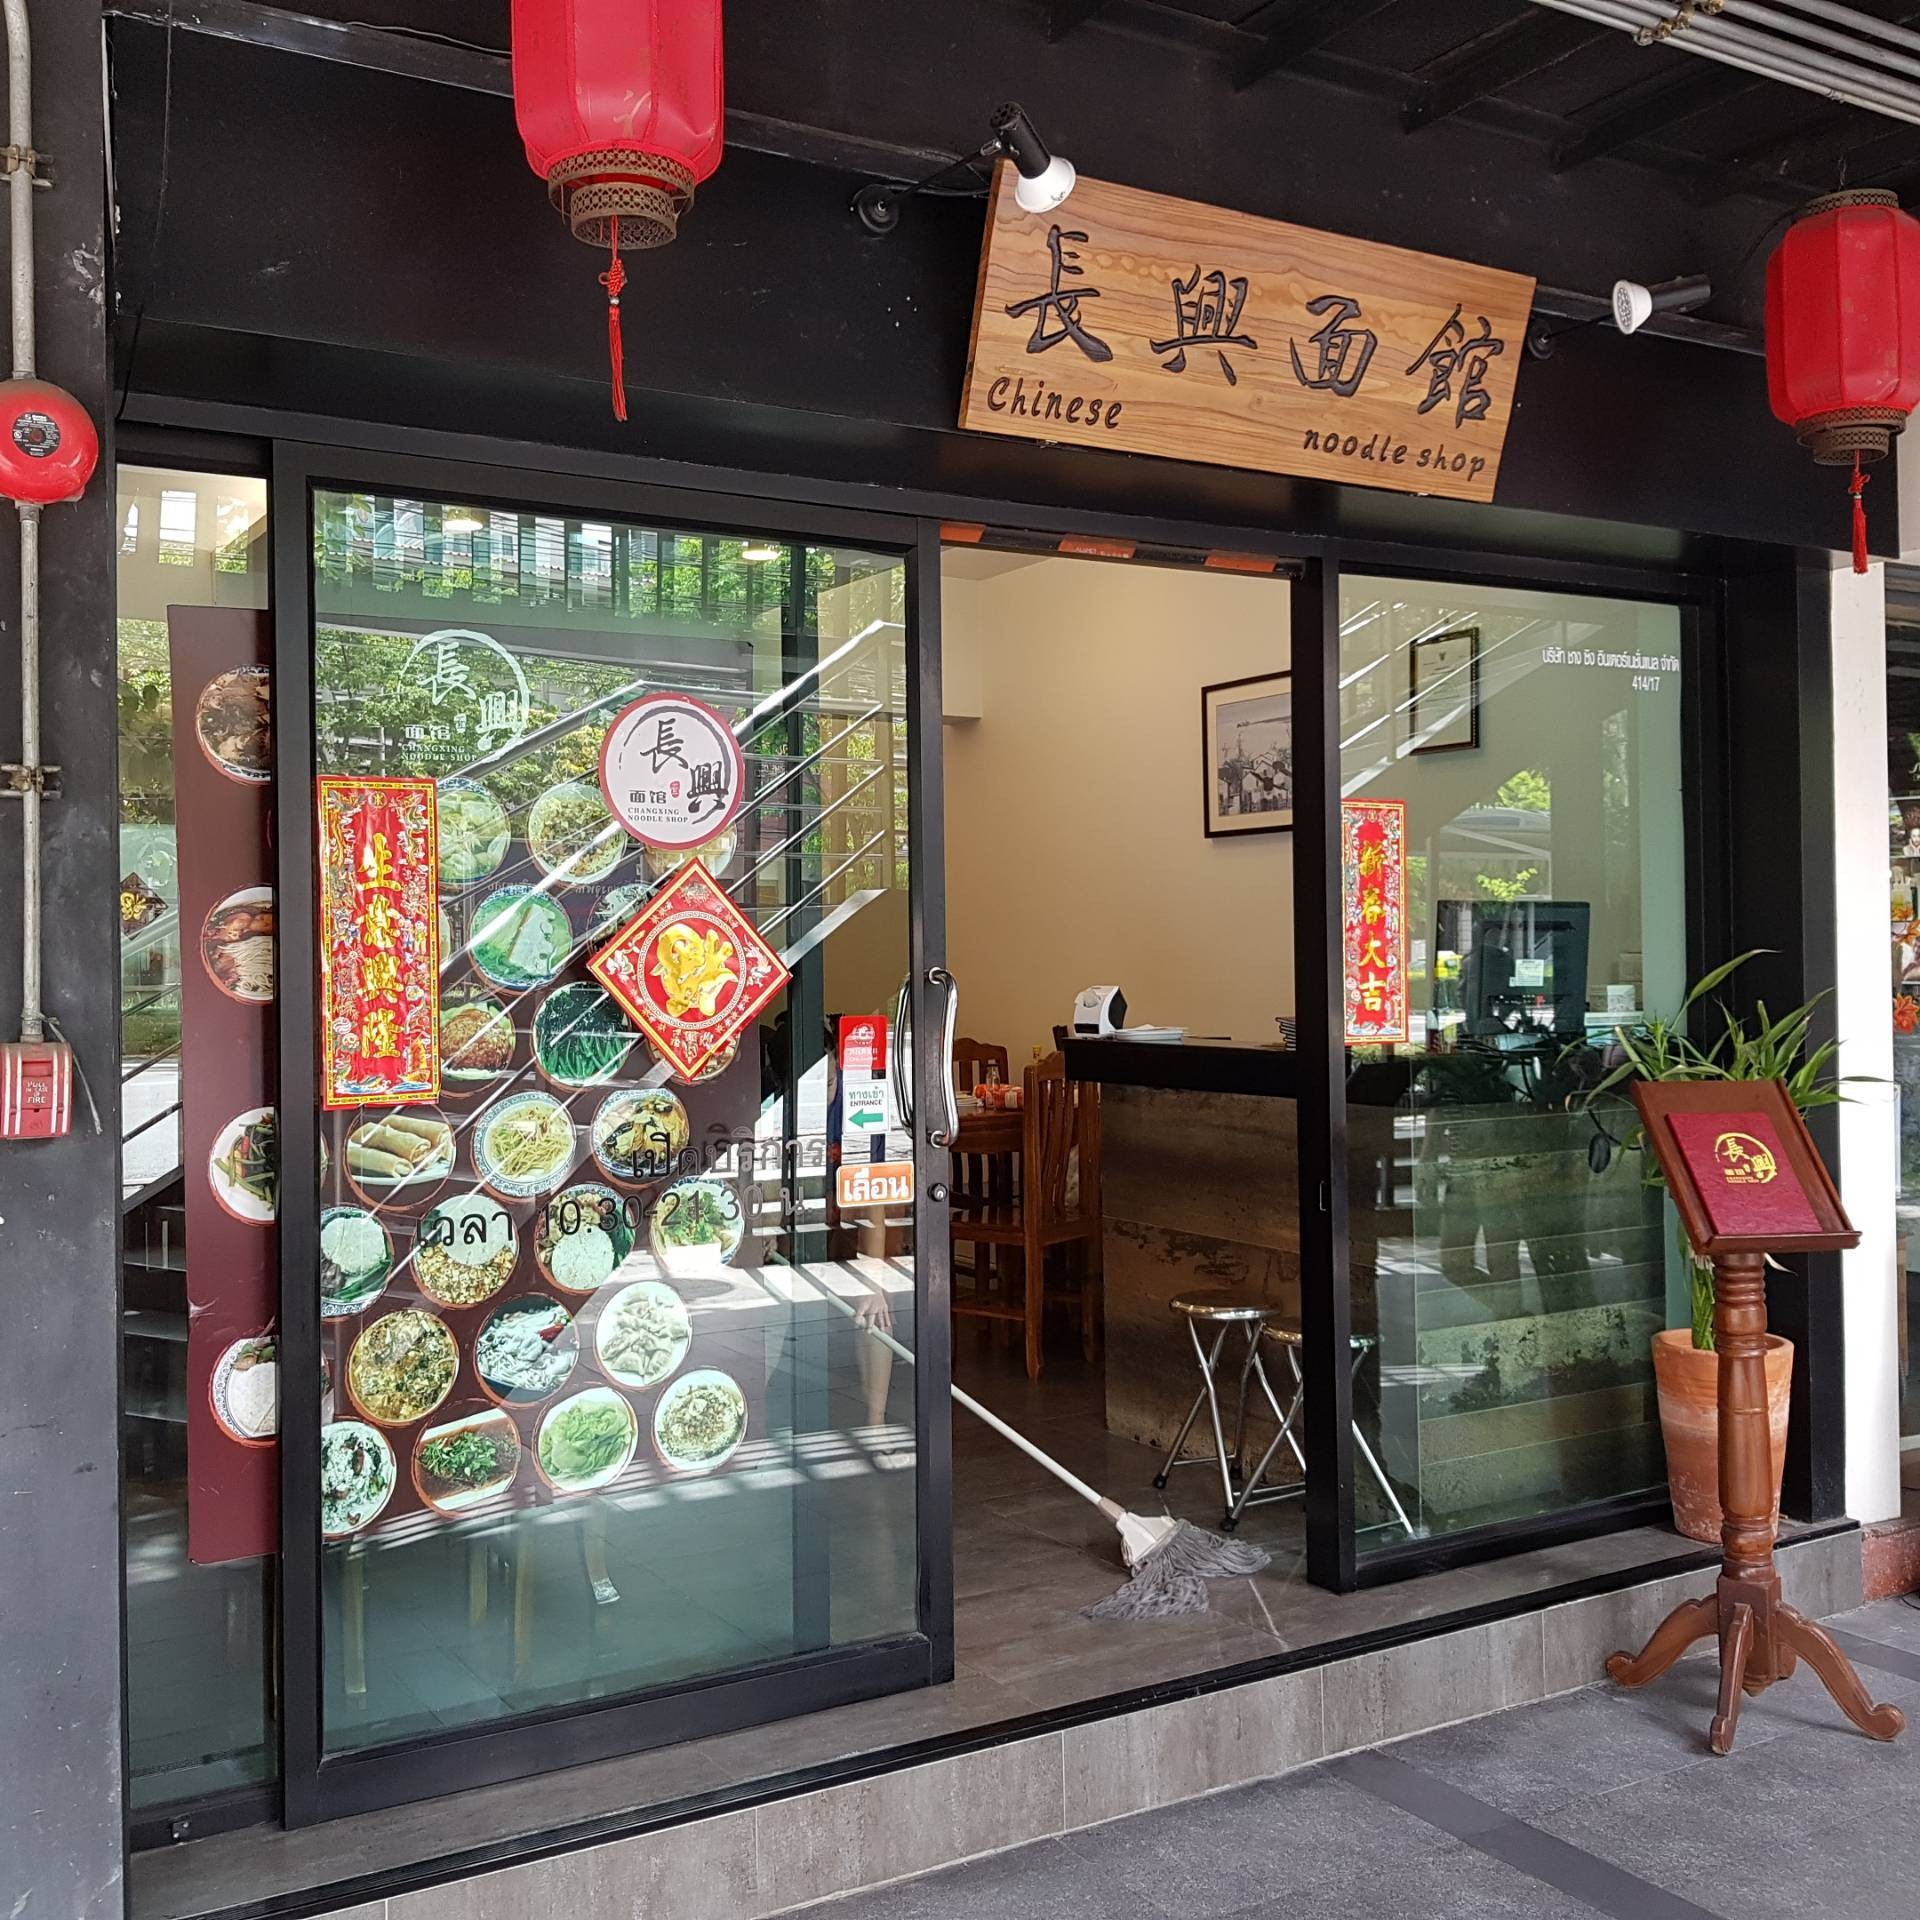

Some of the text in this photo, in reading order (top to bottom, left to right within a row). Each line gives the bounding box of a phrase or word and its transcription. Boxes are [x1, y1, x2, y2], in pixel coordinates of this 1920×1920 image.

[986, 376, 1486, 482] Chinese noodle shop
[1631, 674, 1661, 692] 414/17
[627, 806, 680, 816] CHANGXING
[627, 815, 689, 824] NOODLE SHOP
[1358, 841, 1387, 1012] 新春大吉
[26, 1096, 47, 1104] FIRE
[848, 1086, 885, 1100] ทางเข้า
[850, 1099, 883, 1107] ENTRANCE
[416, 1210, 513, 1248] เวลา
